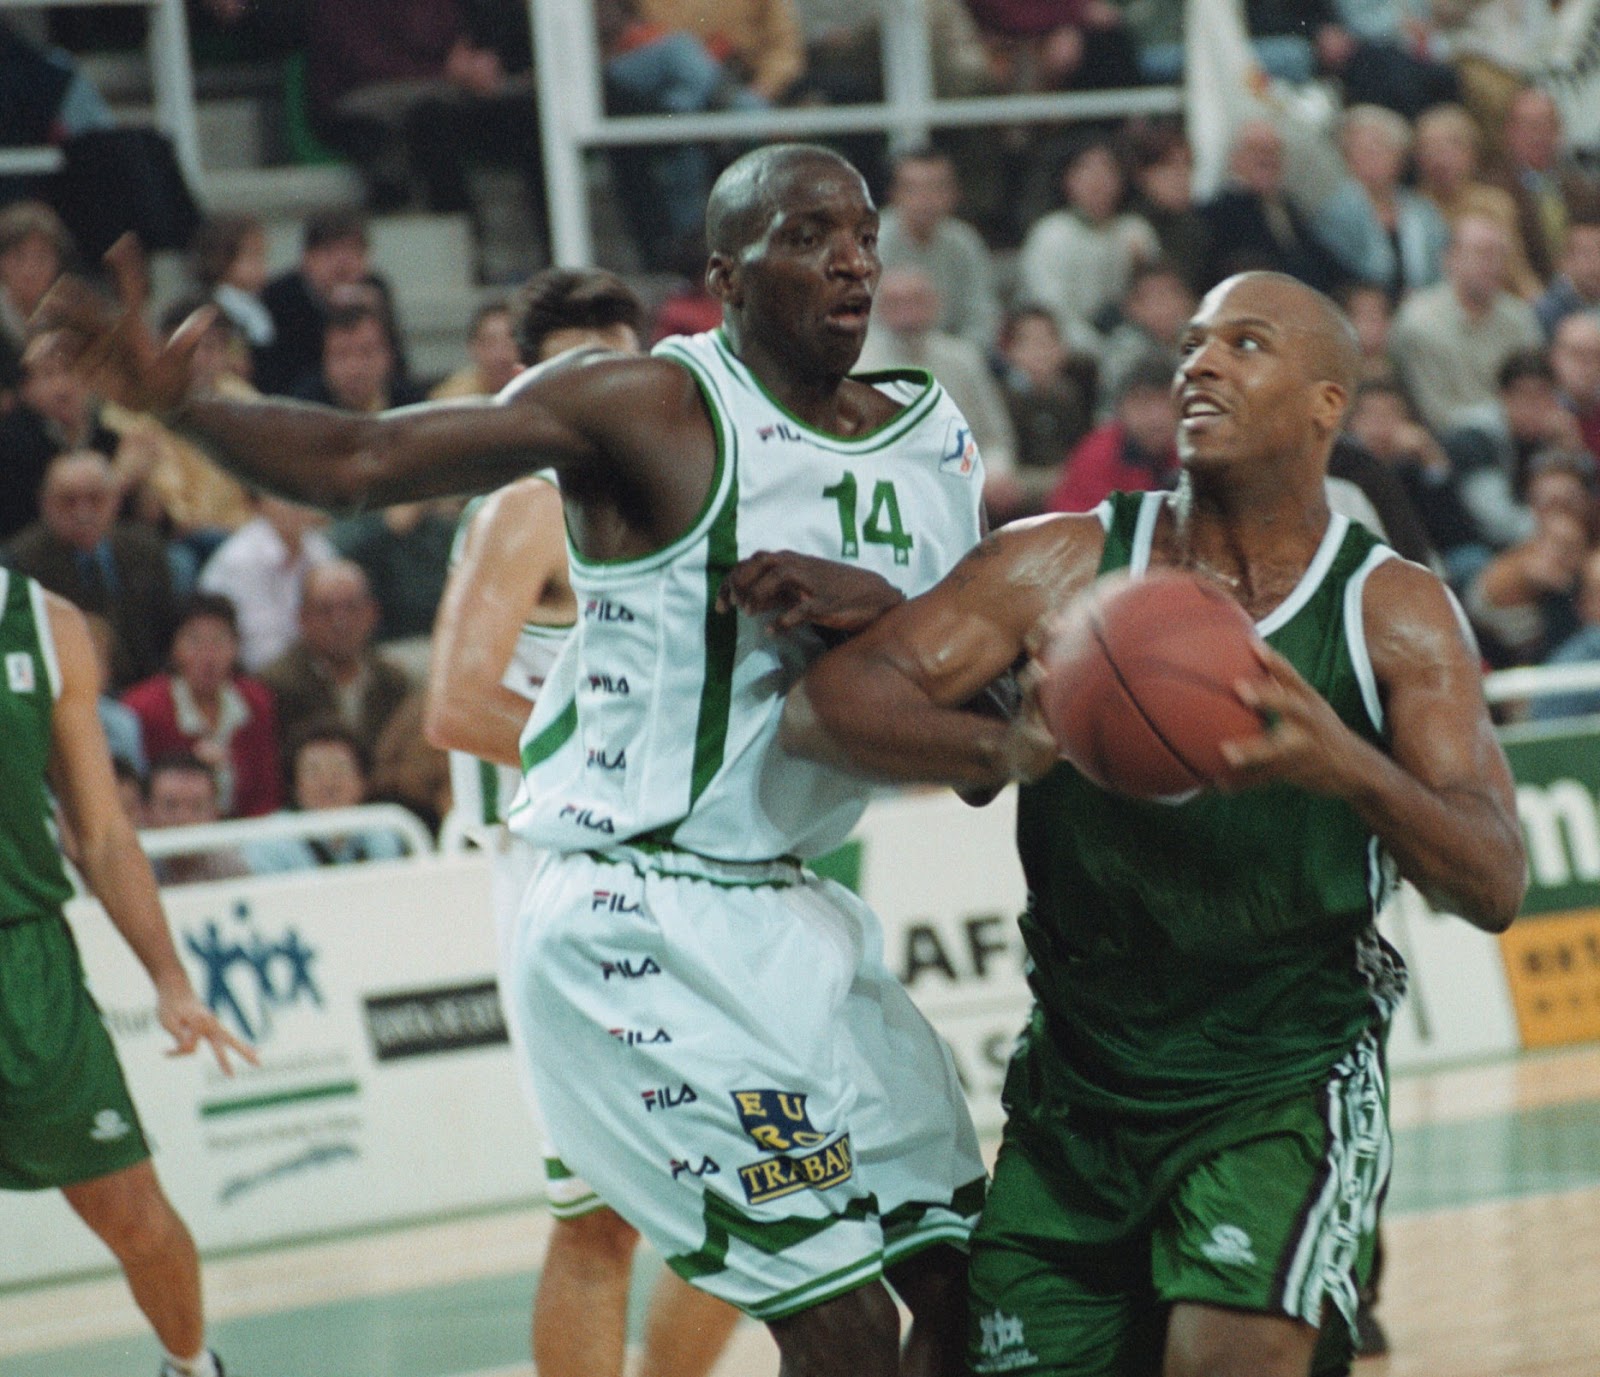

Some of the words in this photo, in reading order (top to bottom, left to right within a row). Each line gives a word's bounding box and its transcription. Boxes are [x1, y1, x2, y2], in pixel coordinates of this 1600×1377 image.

[756, 423, 801, 444] FIL
[822, 469, 914, 566] 14
[584, 600, 634, 621] FILA
[588, 674, 629, 694] FILA
[559, 803, 615, 834] FILA
[600, 956, 661, 980] FILA
[641, 1083, 697, 1112] FILA
